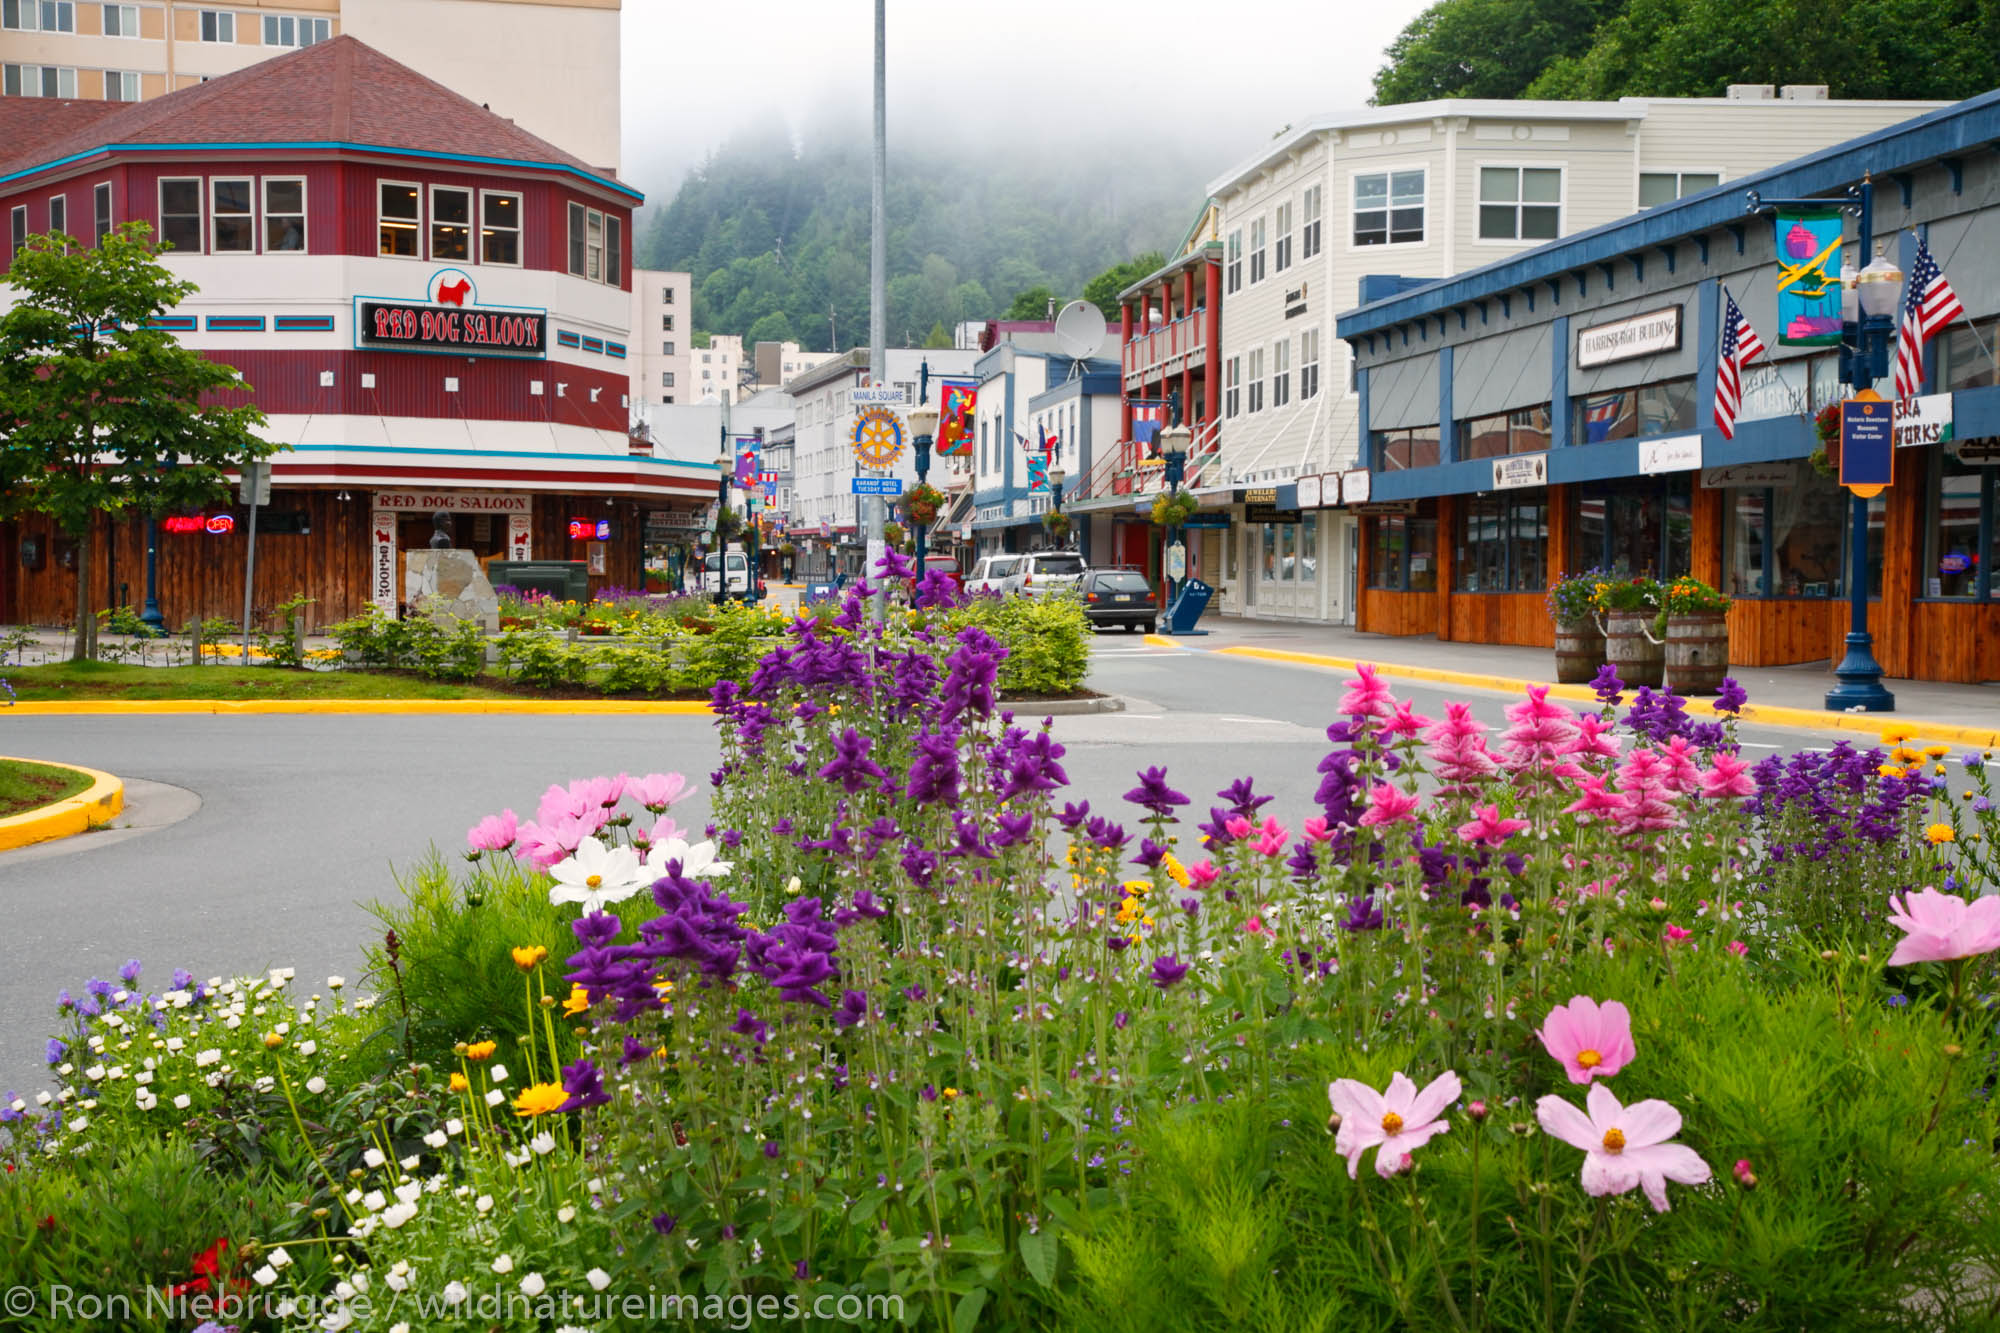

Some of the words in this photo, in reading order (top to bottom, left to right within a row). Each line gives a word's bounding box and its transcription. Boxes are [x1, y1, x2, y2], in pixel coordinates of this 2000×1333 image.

[374, 308, 417, 339] RED
[421, 311, 460, 343] DOG
[463, 313, 540, 347] SALOON
[1639, 319, 1675, 341] BUILDING
[853, 391, 876, 401] MANILA
[878, 391, 904, 401] SQUARE
[379, 495, 416, 507] RED
[422, 496, 456, 508] DOG
[460, 497, 526, 509] SALOON
[206, 518, 233, 530] OPEN
